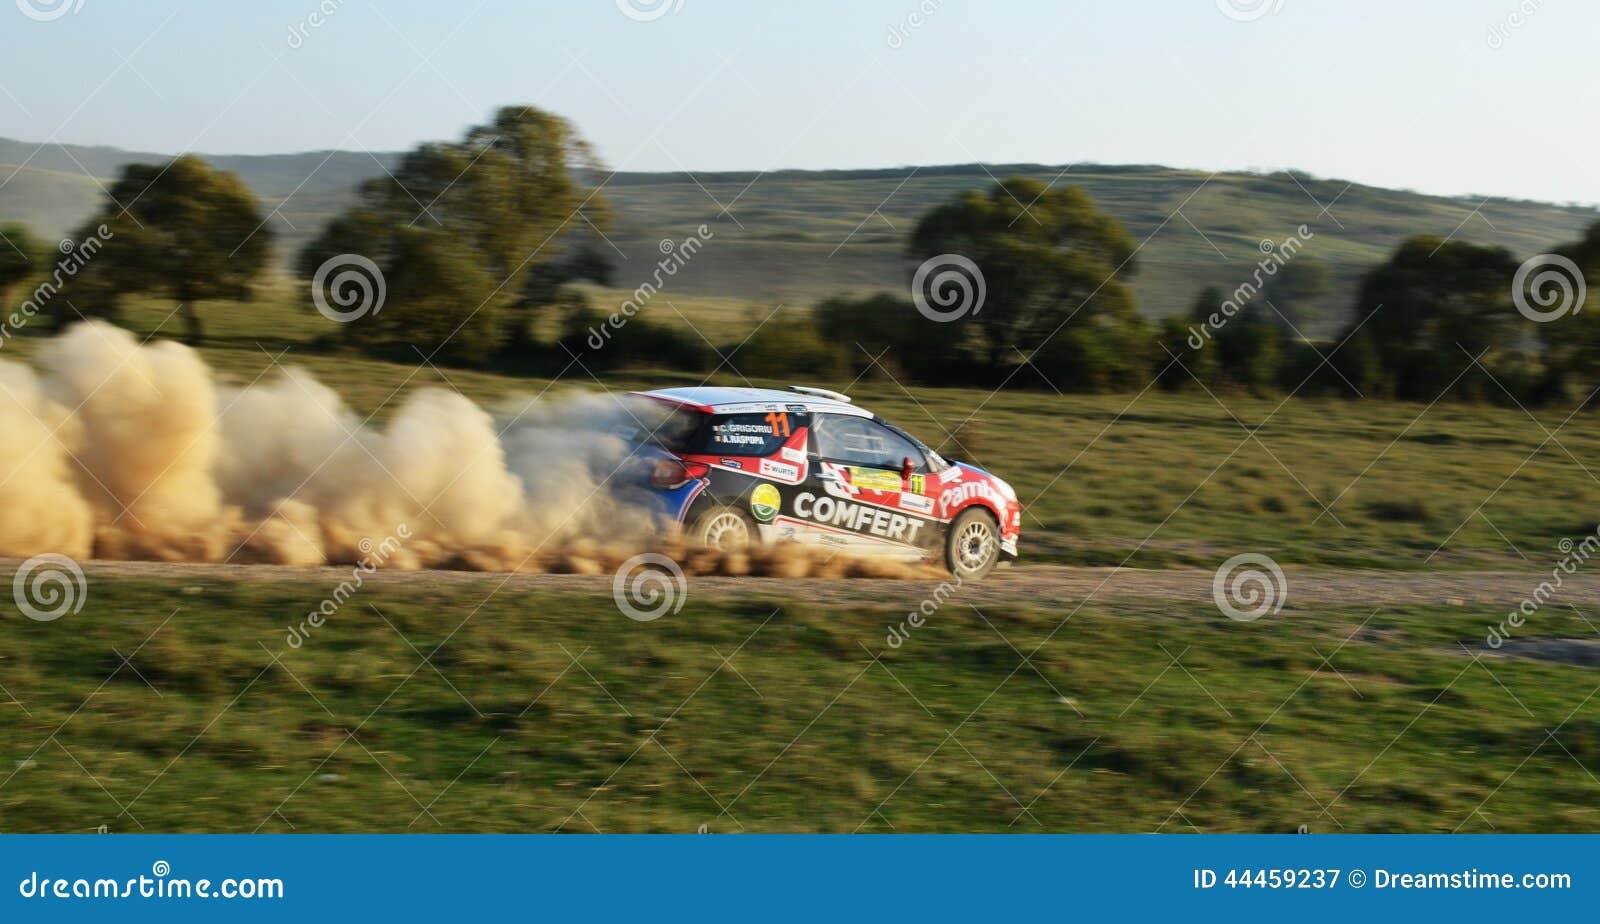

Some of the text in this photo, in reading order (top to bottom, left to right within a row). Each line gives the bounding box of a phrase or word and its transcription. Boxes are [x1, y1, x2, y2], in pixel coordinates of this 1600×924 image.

[729, 424, 773, 433] GRIGORIU
[765, 412, 790, 437] 11
[793, 492, 924, 543] COMFERT
